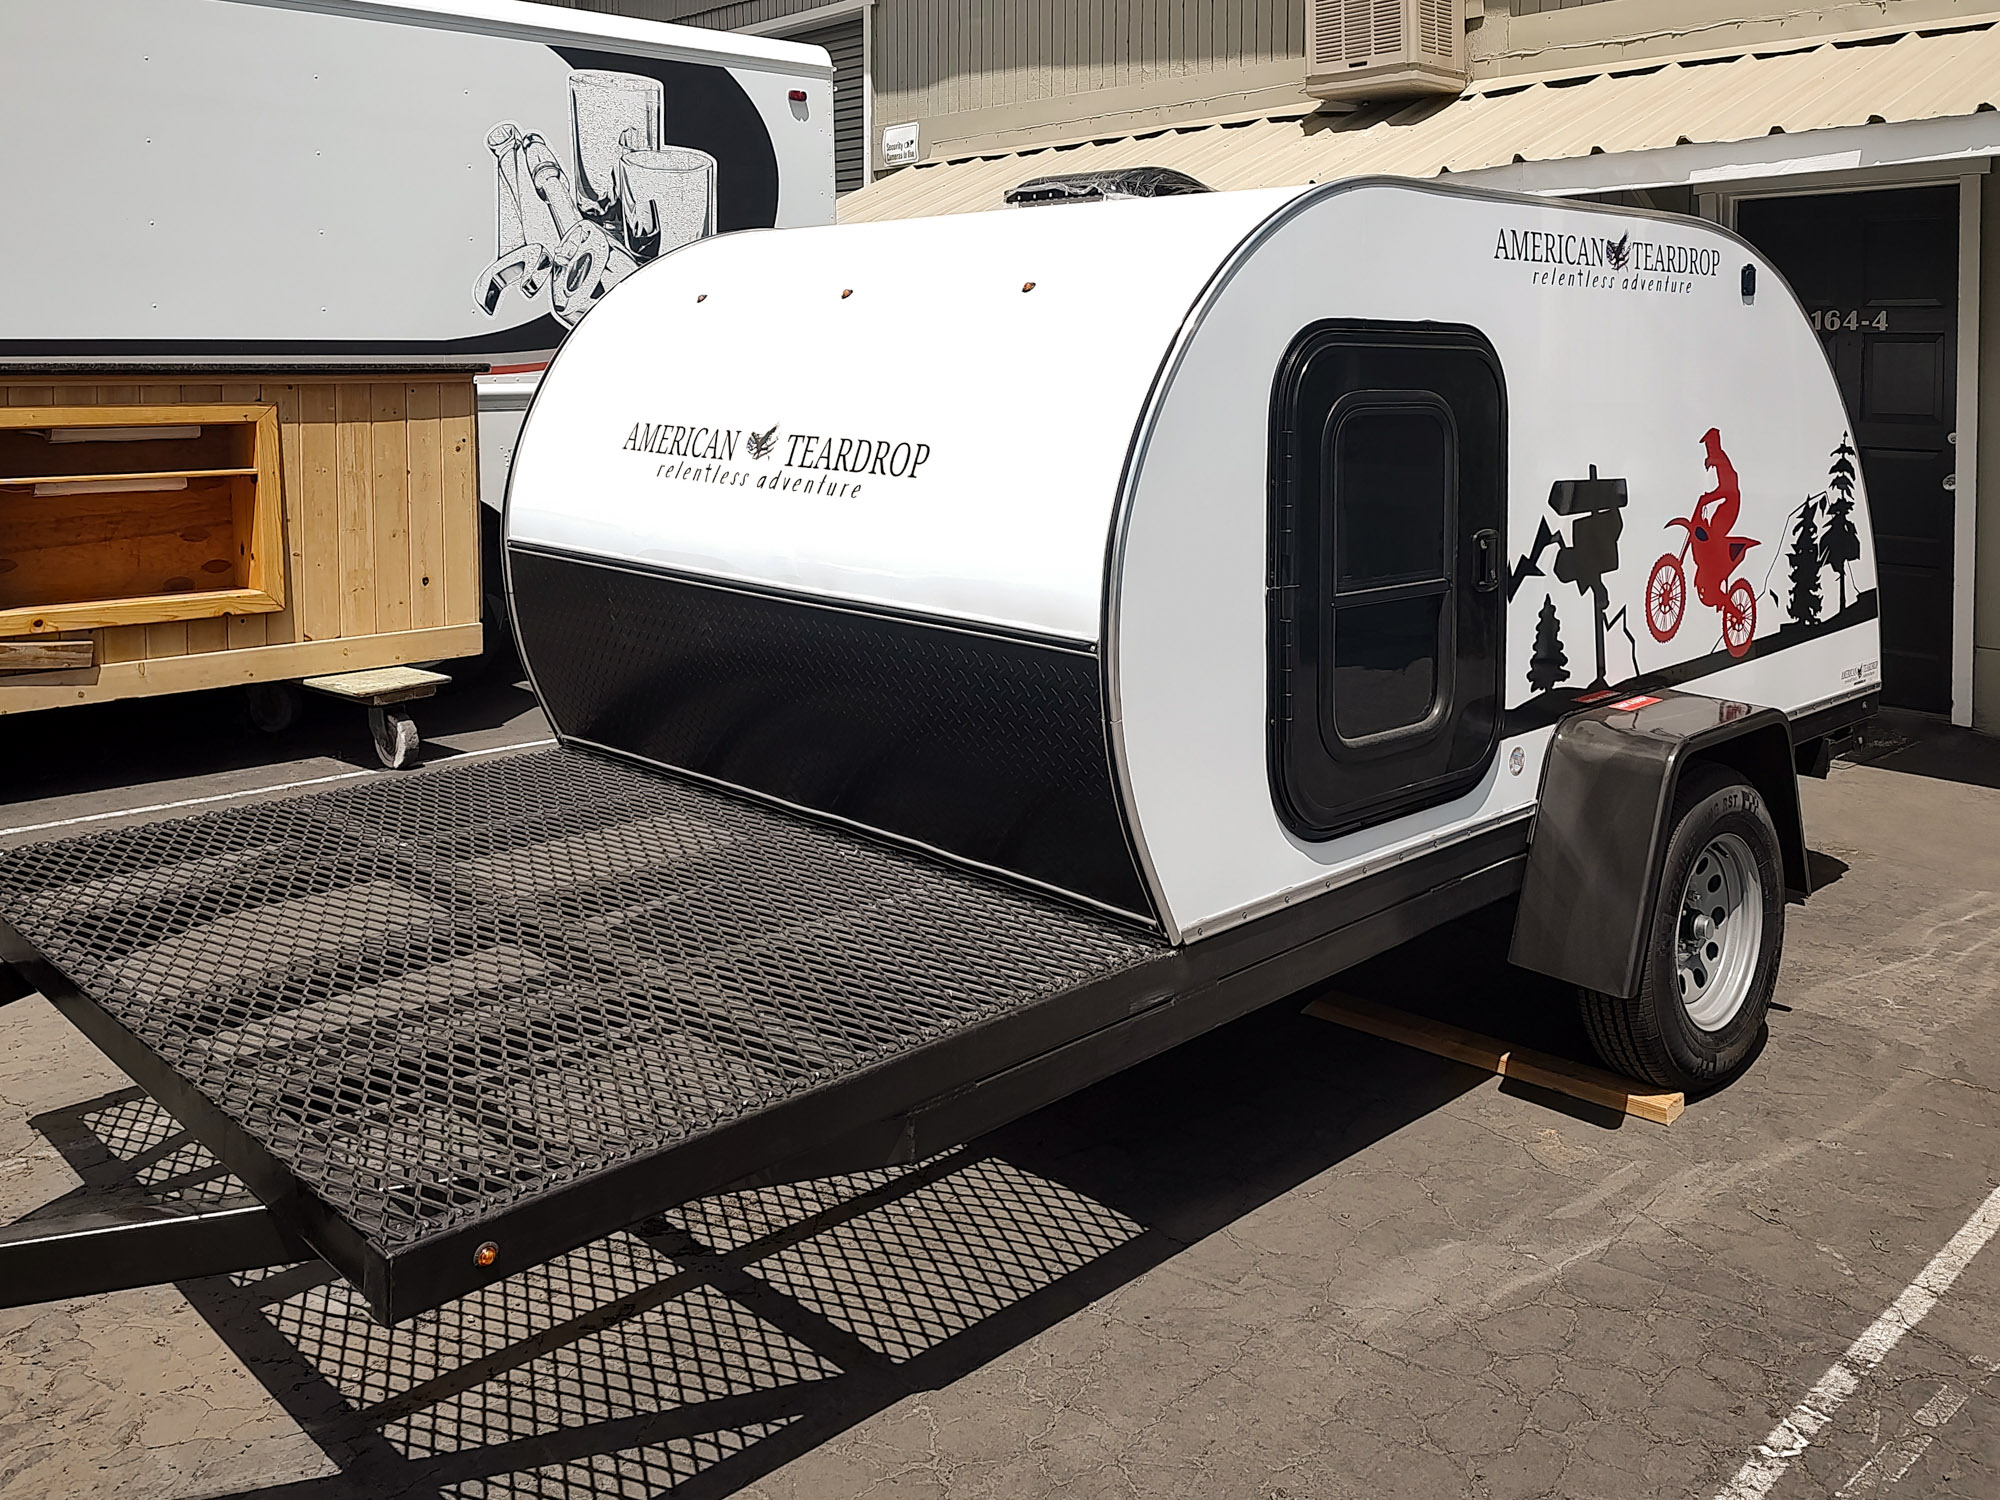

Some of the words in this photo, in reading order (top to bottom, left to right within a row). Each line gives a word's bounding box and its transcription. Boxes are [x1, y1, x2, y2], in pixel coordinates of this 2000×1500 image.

[886, 142, 903, 151] Security
[1493, 228, 1605, 267] AMERICAN
[1632, 242, 1721, 277] TEARDROP
[1533, 267, 1615, 289] relentless
[1622, 275, 1693, 294] adventure
[1811, 310, 1888, 331] 164-4
[622, 422, 741, 461] AMERICAN
[784, 434, 930, 479] TEARDROP
[656, 461, 750, 487] relentless
[756, 471, 862, 499] adventure
